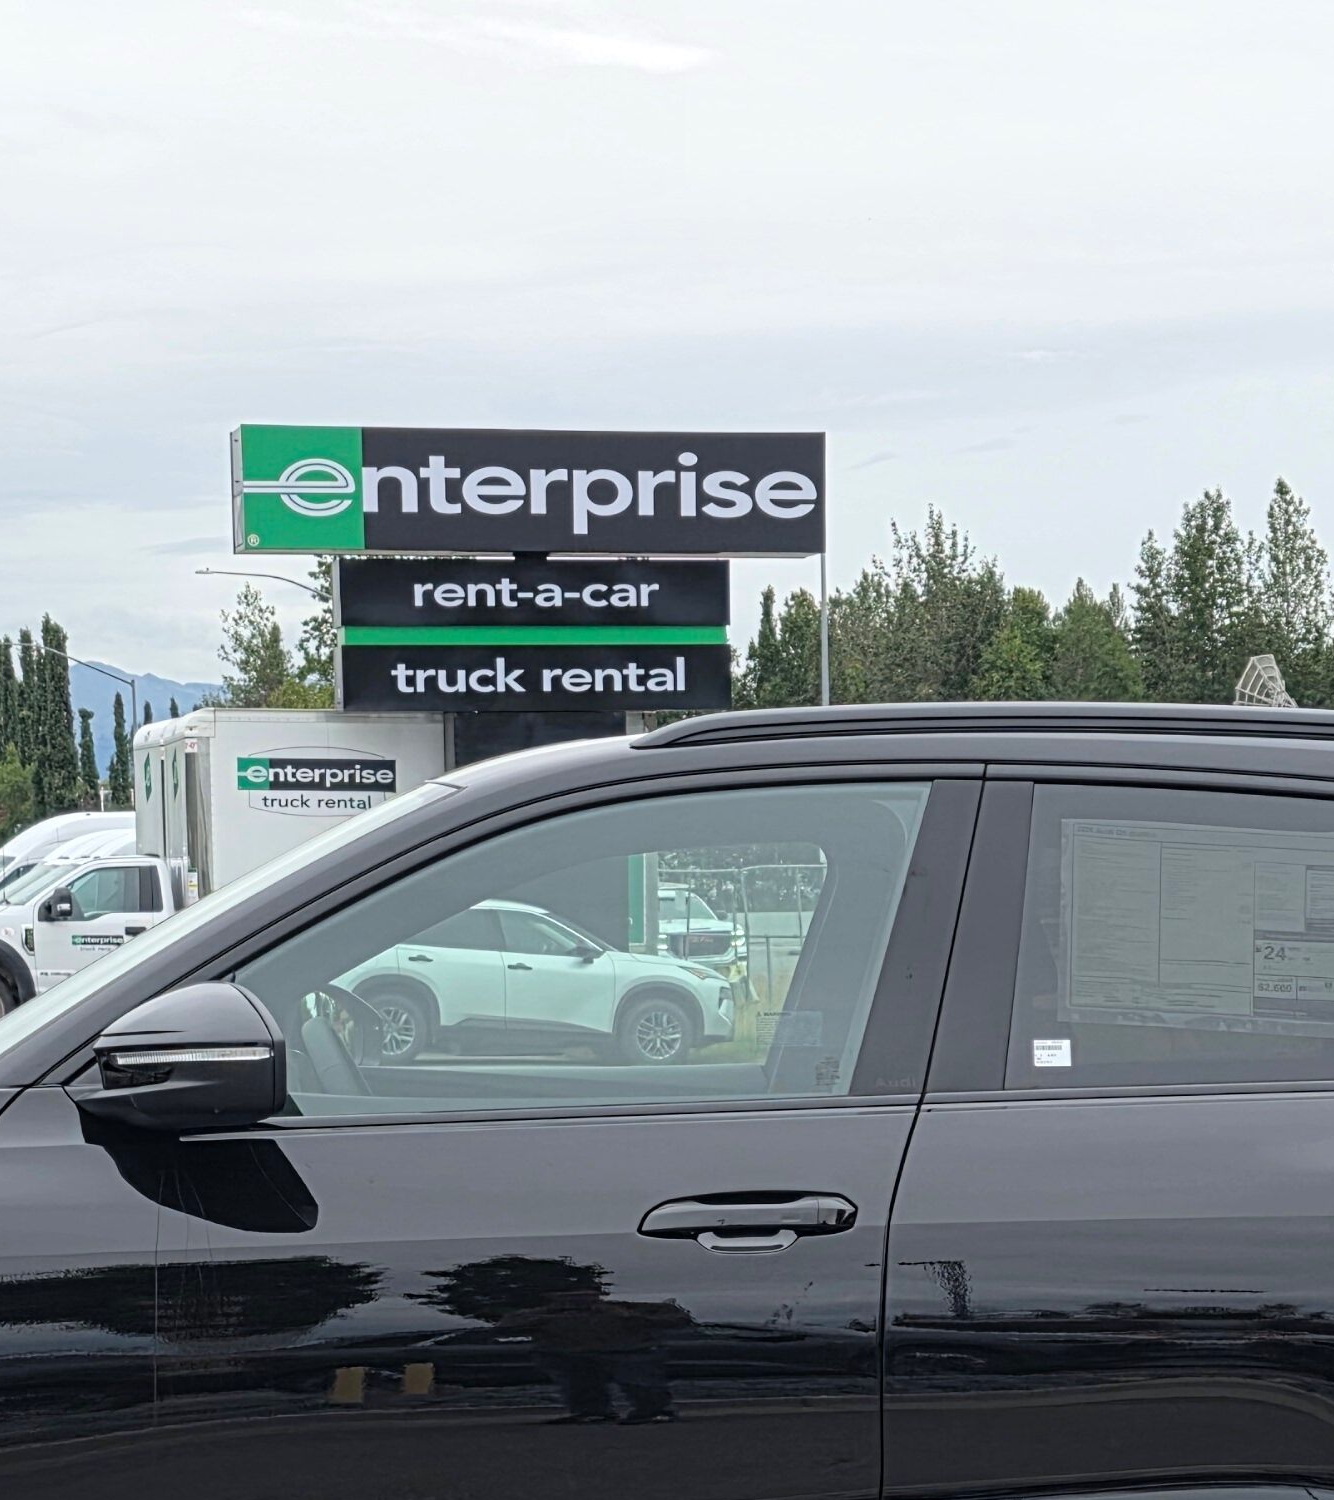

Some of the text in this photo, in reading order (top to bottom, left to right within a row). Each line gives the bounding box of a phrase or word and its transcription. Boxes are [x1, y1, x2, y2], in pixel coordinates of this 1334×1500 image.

[277, 451, 818, 535] enterprise
[412, 577, 660, 608] rent-a-car
[390, 656, 687, 694] truck rental
[246, 764, 395, 788] enterprise
[261, 793, 372, 810] truck rental
[75, 934, 125, 946] enterprise
[875, 1076, 917, 1088] Audi
